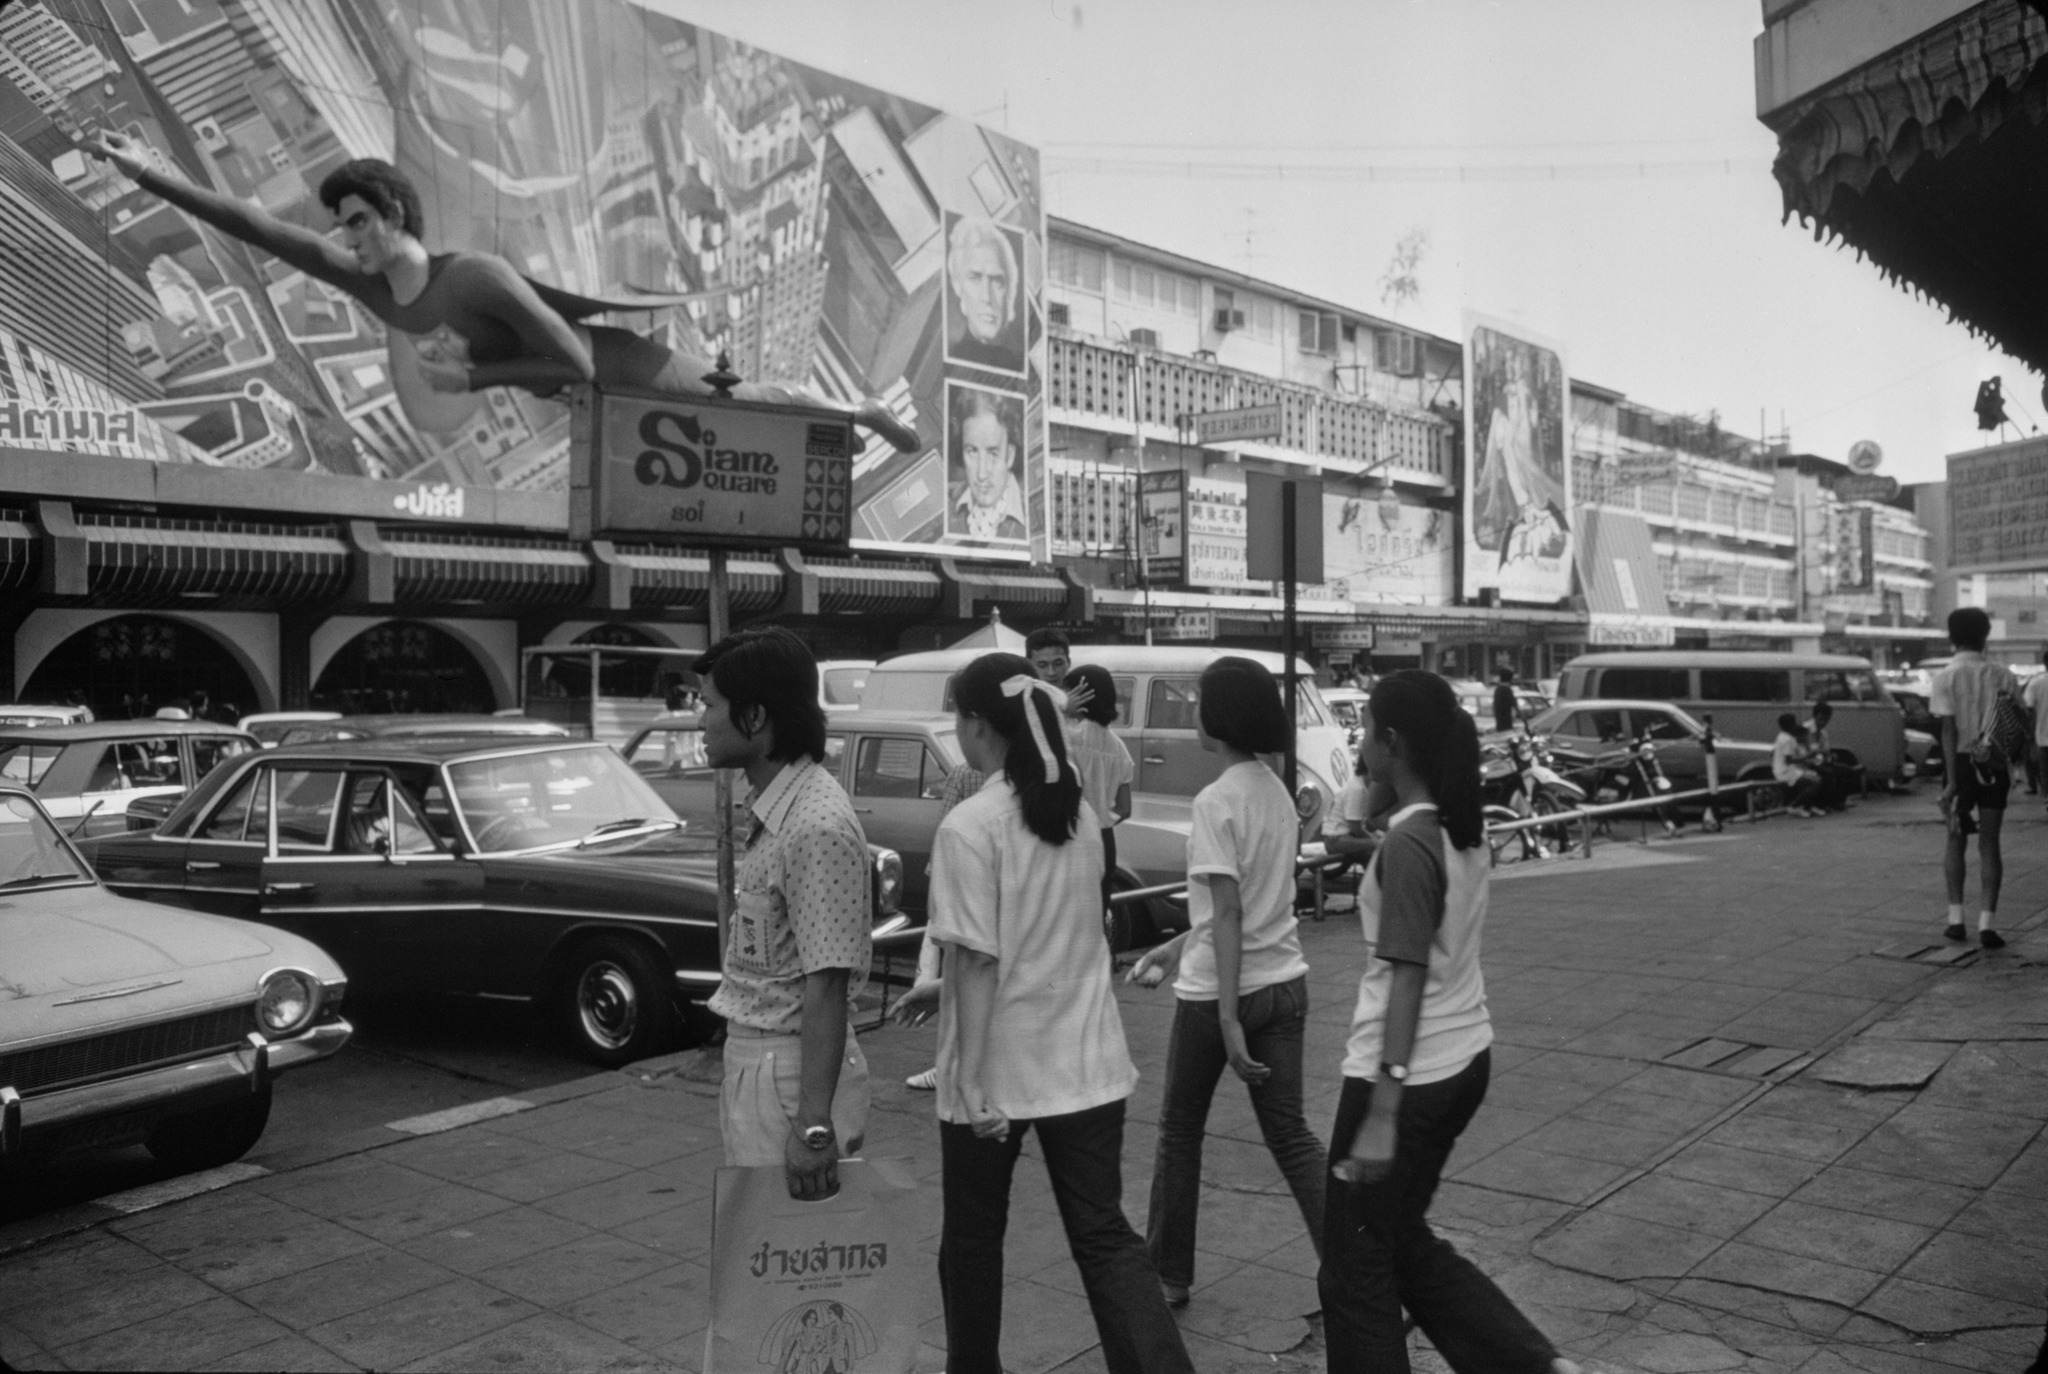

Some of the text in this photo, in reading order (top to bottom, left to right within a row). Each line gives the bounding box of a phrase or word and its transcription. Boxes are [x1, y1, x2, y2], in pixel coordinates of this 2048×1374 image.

[635, 411, 779, 488] Siam
[408, 482, 464, 517] ปารีส
[671, 499, 705, 522] soi
[750, 1240, 887, 1278] ชายสากล
